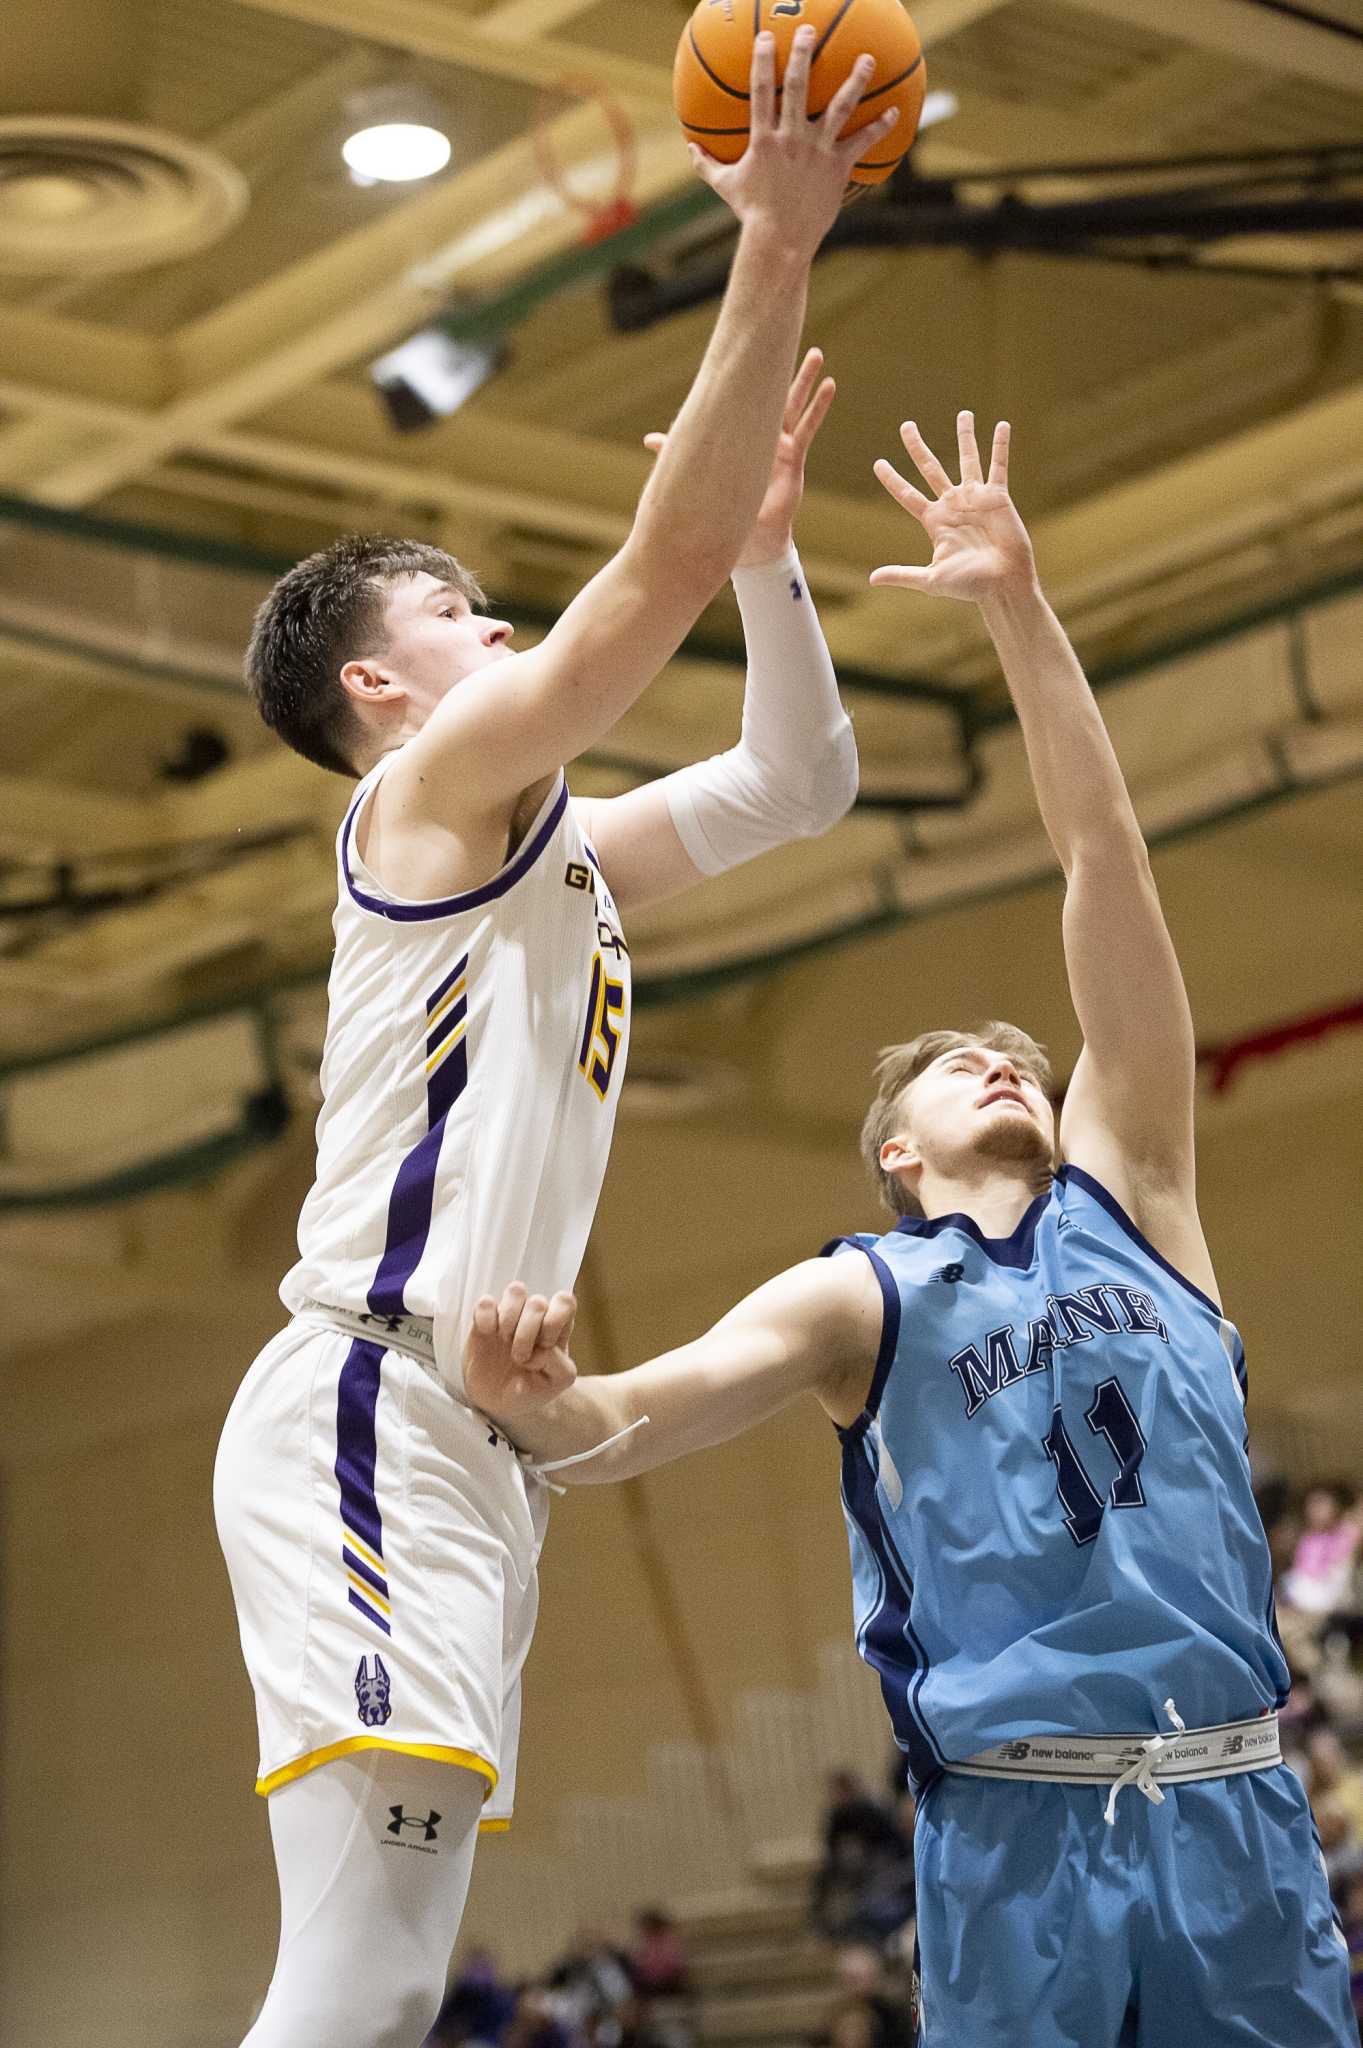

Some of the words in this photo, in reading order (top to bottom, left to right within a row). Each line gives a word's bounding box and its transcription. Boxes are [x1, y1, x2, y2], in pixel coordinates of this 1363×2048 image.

[1042, 1376, 1147, 1546] 11
[1031, 1748, 1053, 1758] new
[1174, 1746, 1209, 1759] balance
